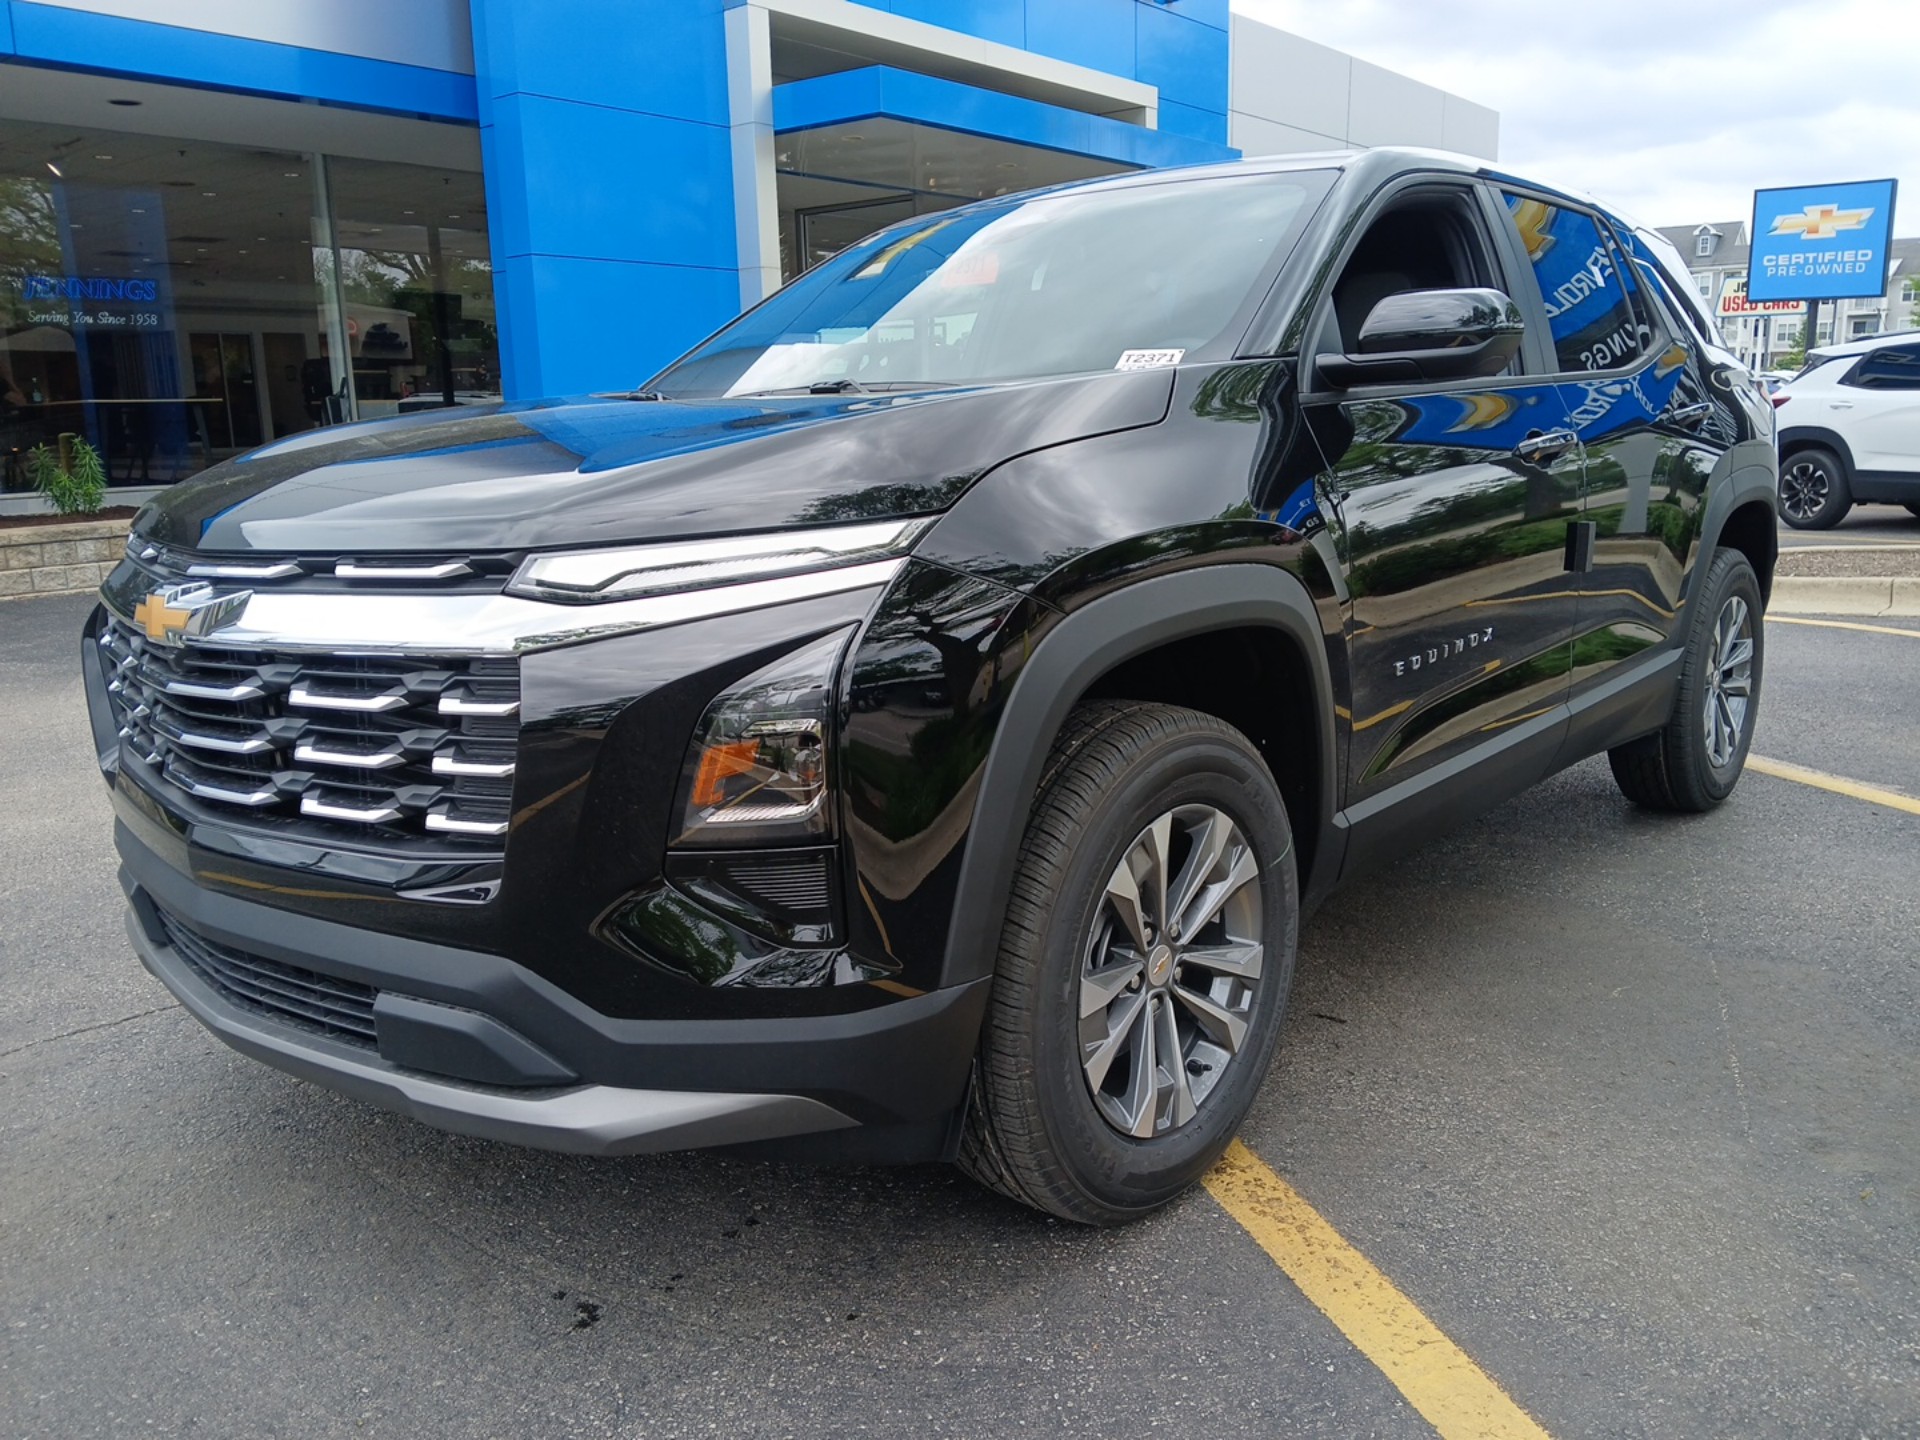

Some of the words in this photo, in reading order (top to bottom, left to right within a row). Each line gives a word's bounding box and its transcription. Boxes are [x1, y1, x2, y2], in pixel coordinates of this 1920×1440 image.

[1763, 249, 1873, 266] CERTIFIED
[1767, 262, 1866, 277] PRE-OWNED
[24, 276, 157, 301] JENNINGS
[28, 310, 69, 325] Serving
[73, 311, 94, 324] You
[97, 311, 126, 325] Since
[130, 313, 158, 326] 1958
[1124, 352, 1176, 364] T2371
[1393, 627, 1493, 677] EQUINOX
